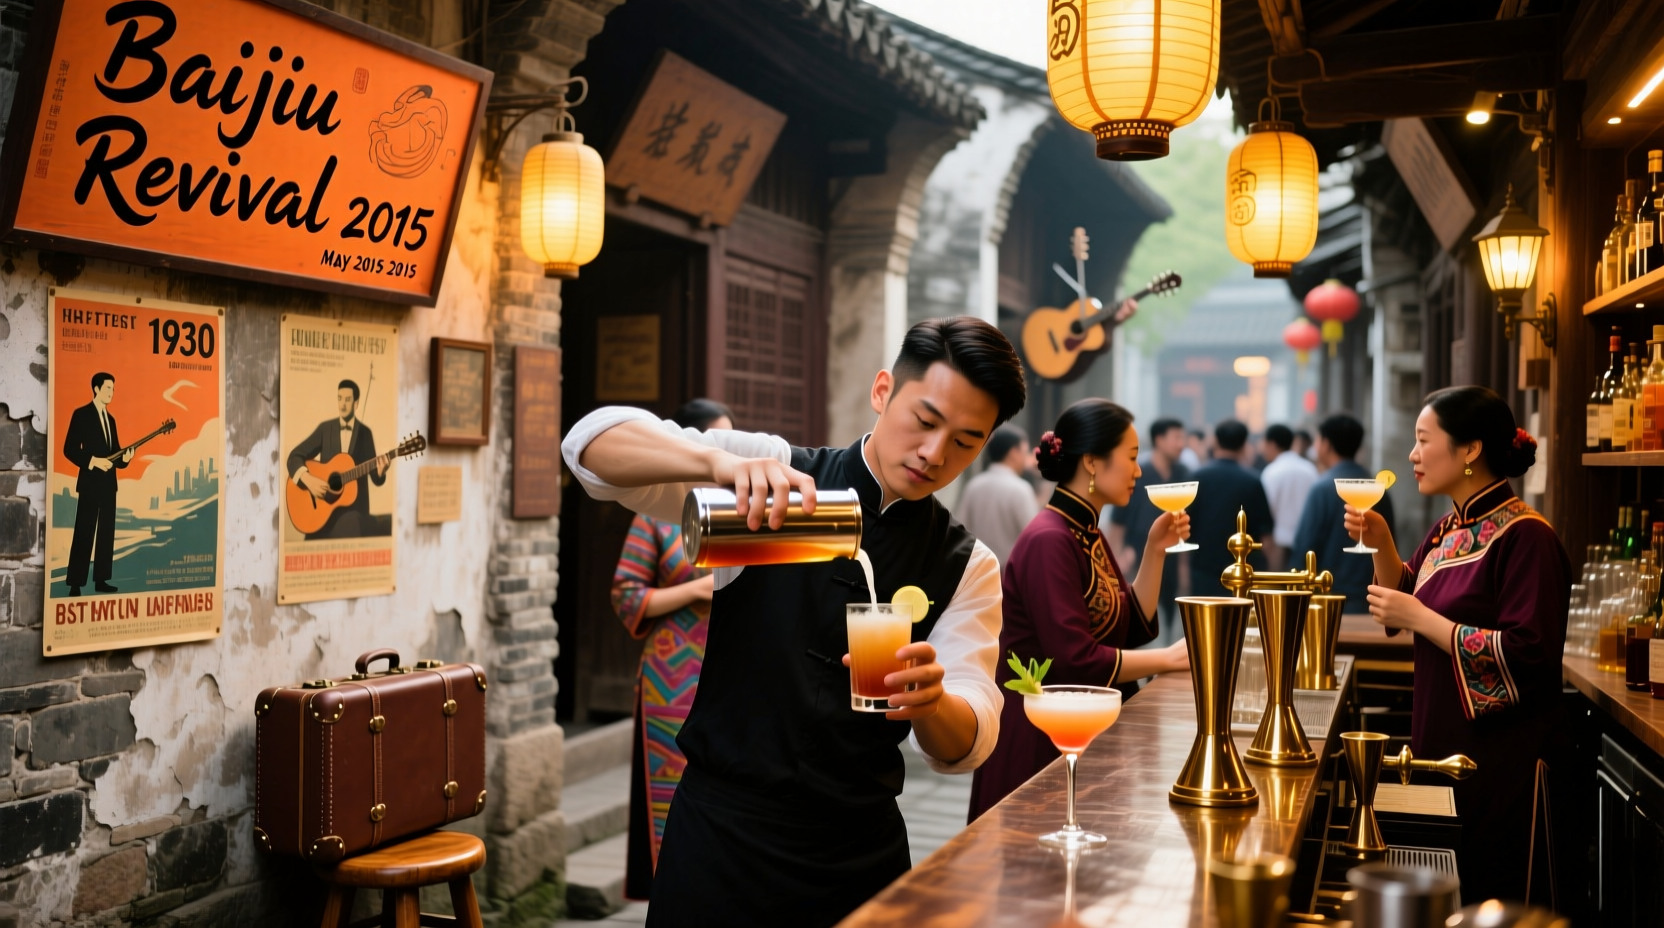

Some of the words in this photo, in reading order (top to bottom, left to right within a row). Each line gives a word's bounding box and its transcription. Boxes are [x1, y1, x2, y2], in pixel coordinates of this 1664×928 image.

[94, 0, 341, 149] Baijiu
[74, 115, 338, 233] Revival
[341, 197, 435, 251] 2015
[353, 255, 385, 274] 2015
[386, 260, 418, 279] 2015
[148, 318, 215, 359] 1930
